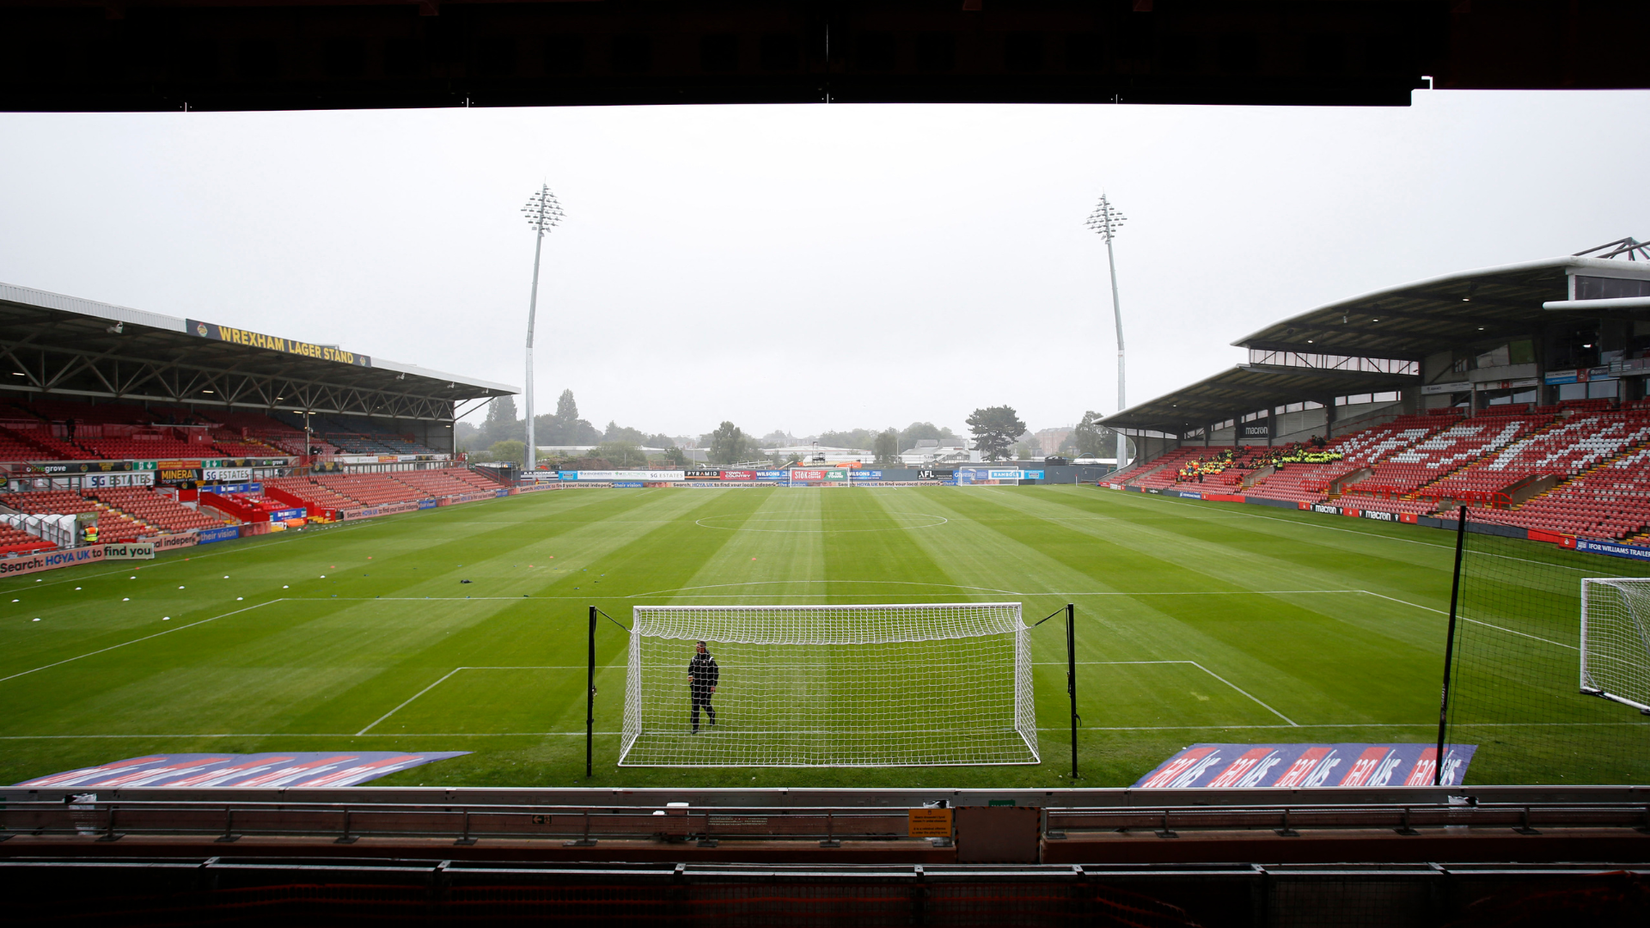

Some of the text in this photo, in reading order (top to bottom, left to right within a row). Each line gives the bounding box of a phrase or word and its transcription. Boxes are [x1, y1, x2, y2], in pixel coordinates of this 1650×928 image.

[218, 325, 354, 364] WREXHAM LAGER STAND
[1246, 426, 1268, 435] macron
[92, 476, 105, 486] SG
[109, 474, 151, 485] ESTATES
[162, 470, 193, 480] MINERA
[206, 470, 248, 480] SG ESTATES
[1315, 504, 1337, 514] macron
[1366, 510, 1391, 521] macron
[201, 528, 237, 542] their vision
[1602, 544, 1629, 554] WILLIAMS
[0, 546, 151, 573] Search: HOYA UK to find you
